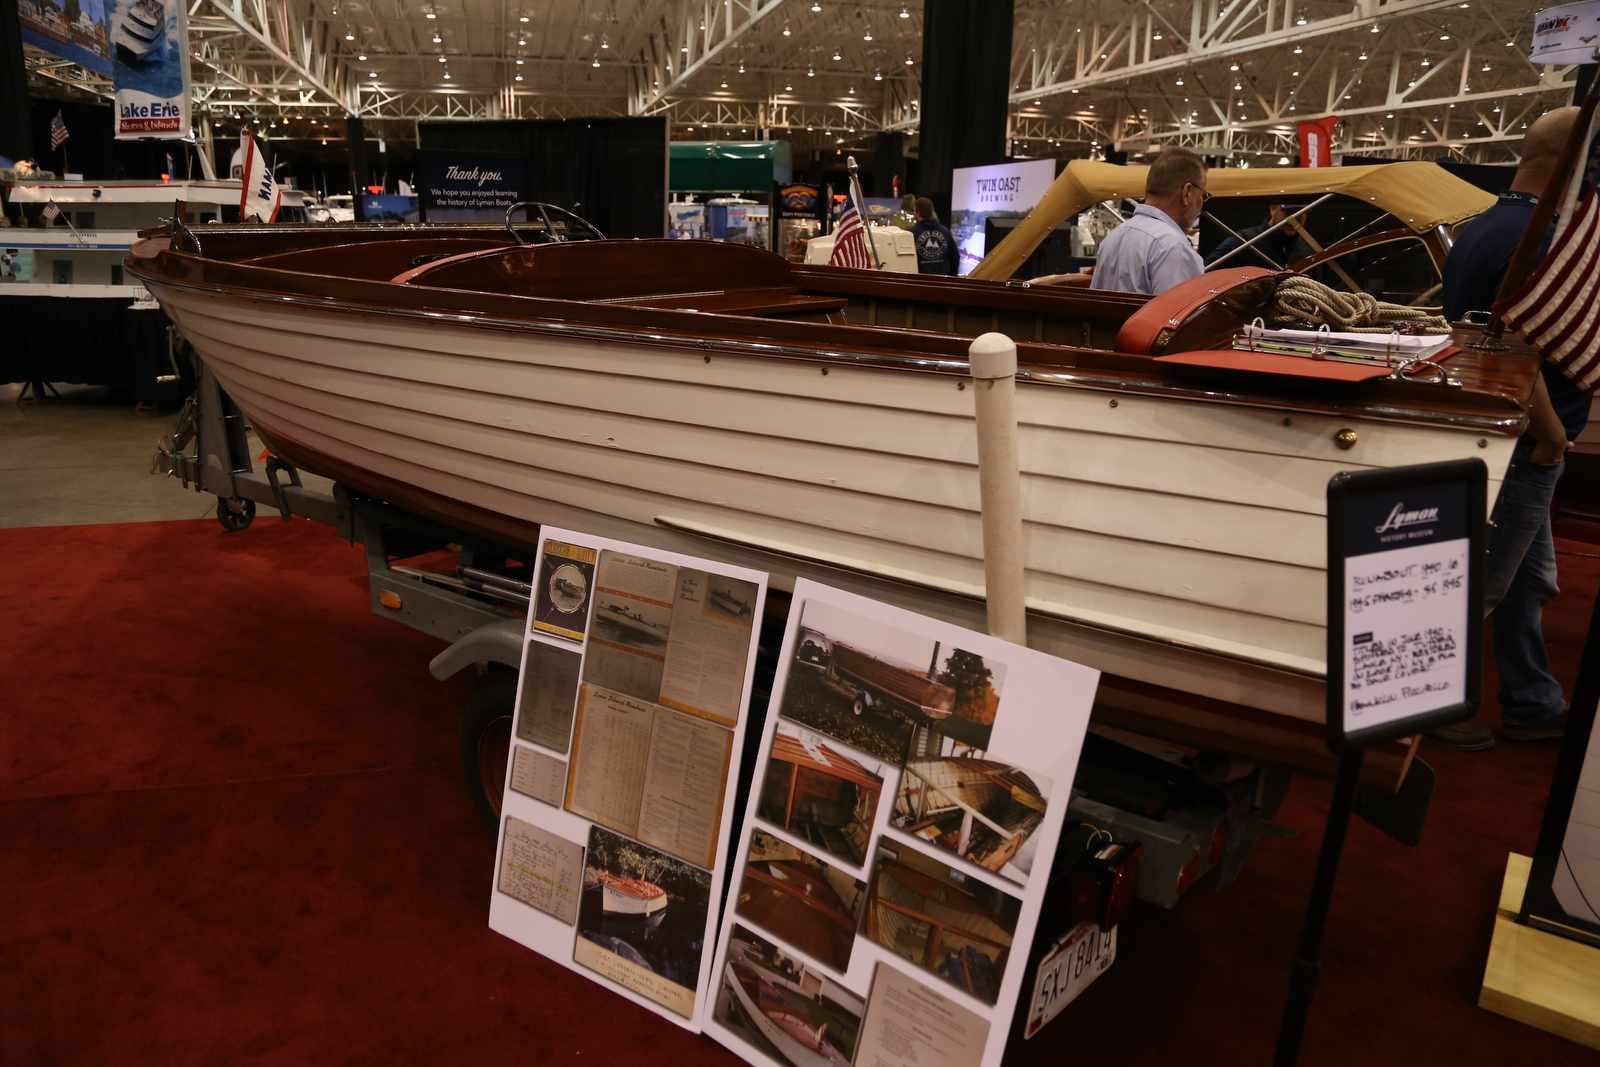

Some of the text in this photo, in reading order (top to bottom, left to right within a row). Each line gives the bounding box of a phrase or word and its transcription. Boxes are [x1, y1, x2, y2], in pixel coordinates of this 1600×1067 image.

[120, 102, 180, 118] Lake Erie
[121, 120, 178, 131] Shores & Islands
[445, 165, 503, 187] Thank you.
[430, 188, 518, 198] We hope you enjoyed learning
[976, 177, 1021, 194] TWIN OAST
[447, 199, 468, 208] history
[476, 199, 495, 207] Lyman
[981, 194, 1014, 202] BREWING
[1374, 501, 1439, 534] Lyman
[1380, 528, 1434, 543] HISTORY MUSEUM
